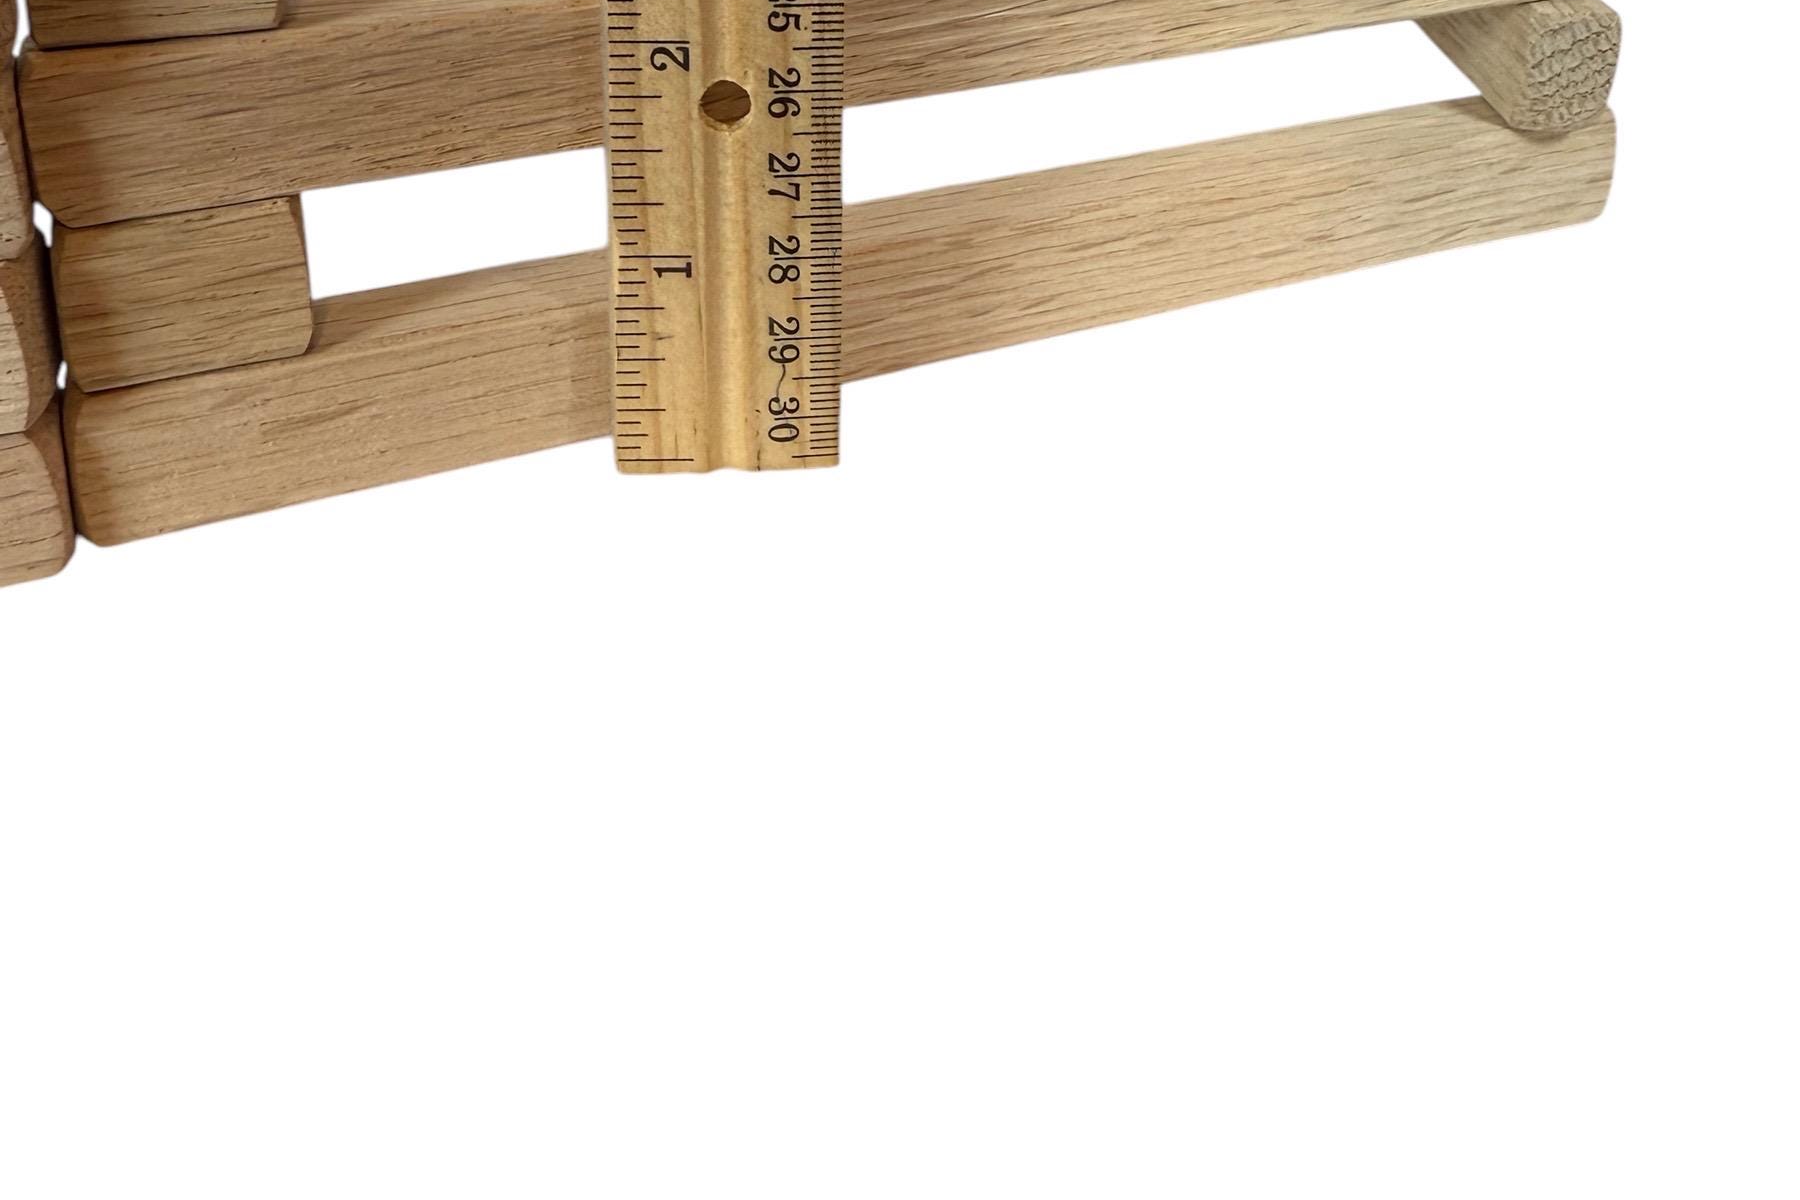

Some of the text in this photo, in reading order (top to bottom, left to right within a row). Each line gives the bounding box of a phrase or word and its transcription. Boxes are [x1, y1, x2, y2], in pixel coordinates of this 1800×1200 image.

[650, 46, 690, 72] 2
[767, 67, 801, 119] 26
[767, 152, 801, 202] 27
[653, 262, 692, 278] 1
[768, 235, 800, 284] 28
[768, 316, 800, 364] 29
[768, 396, 800, 443] 30
